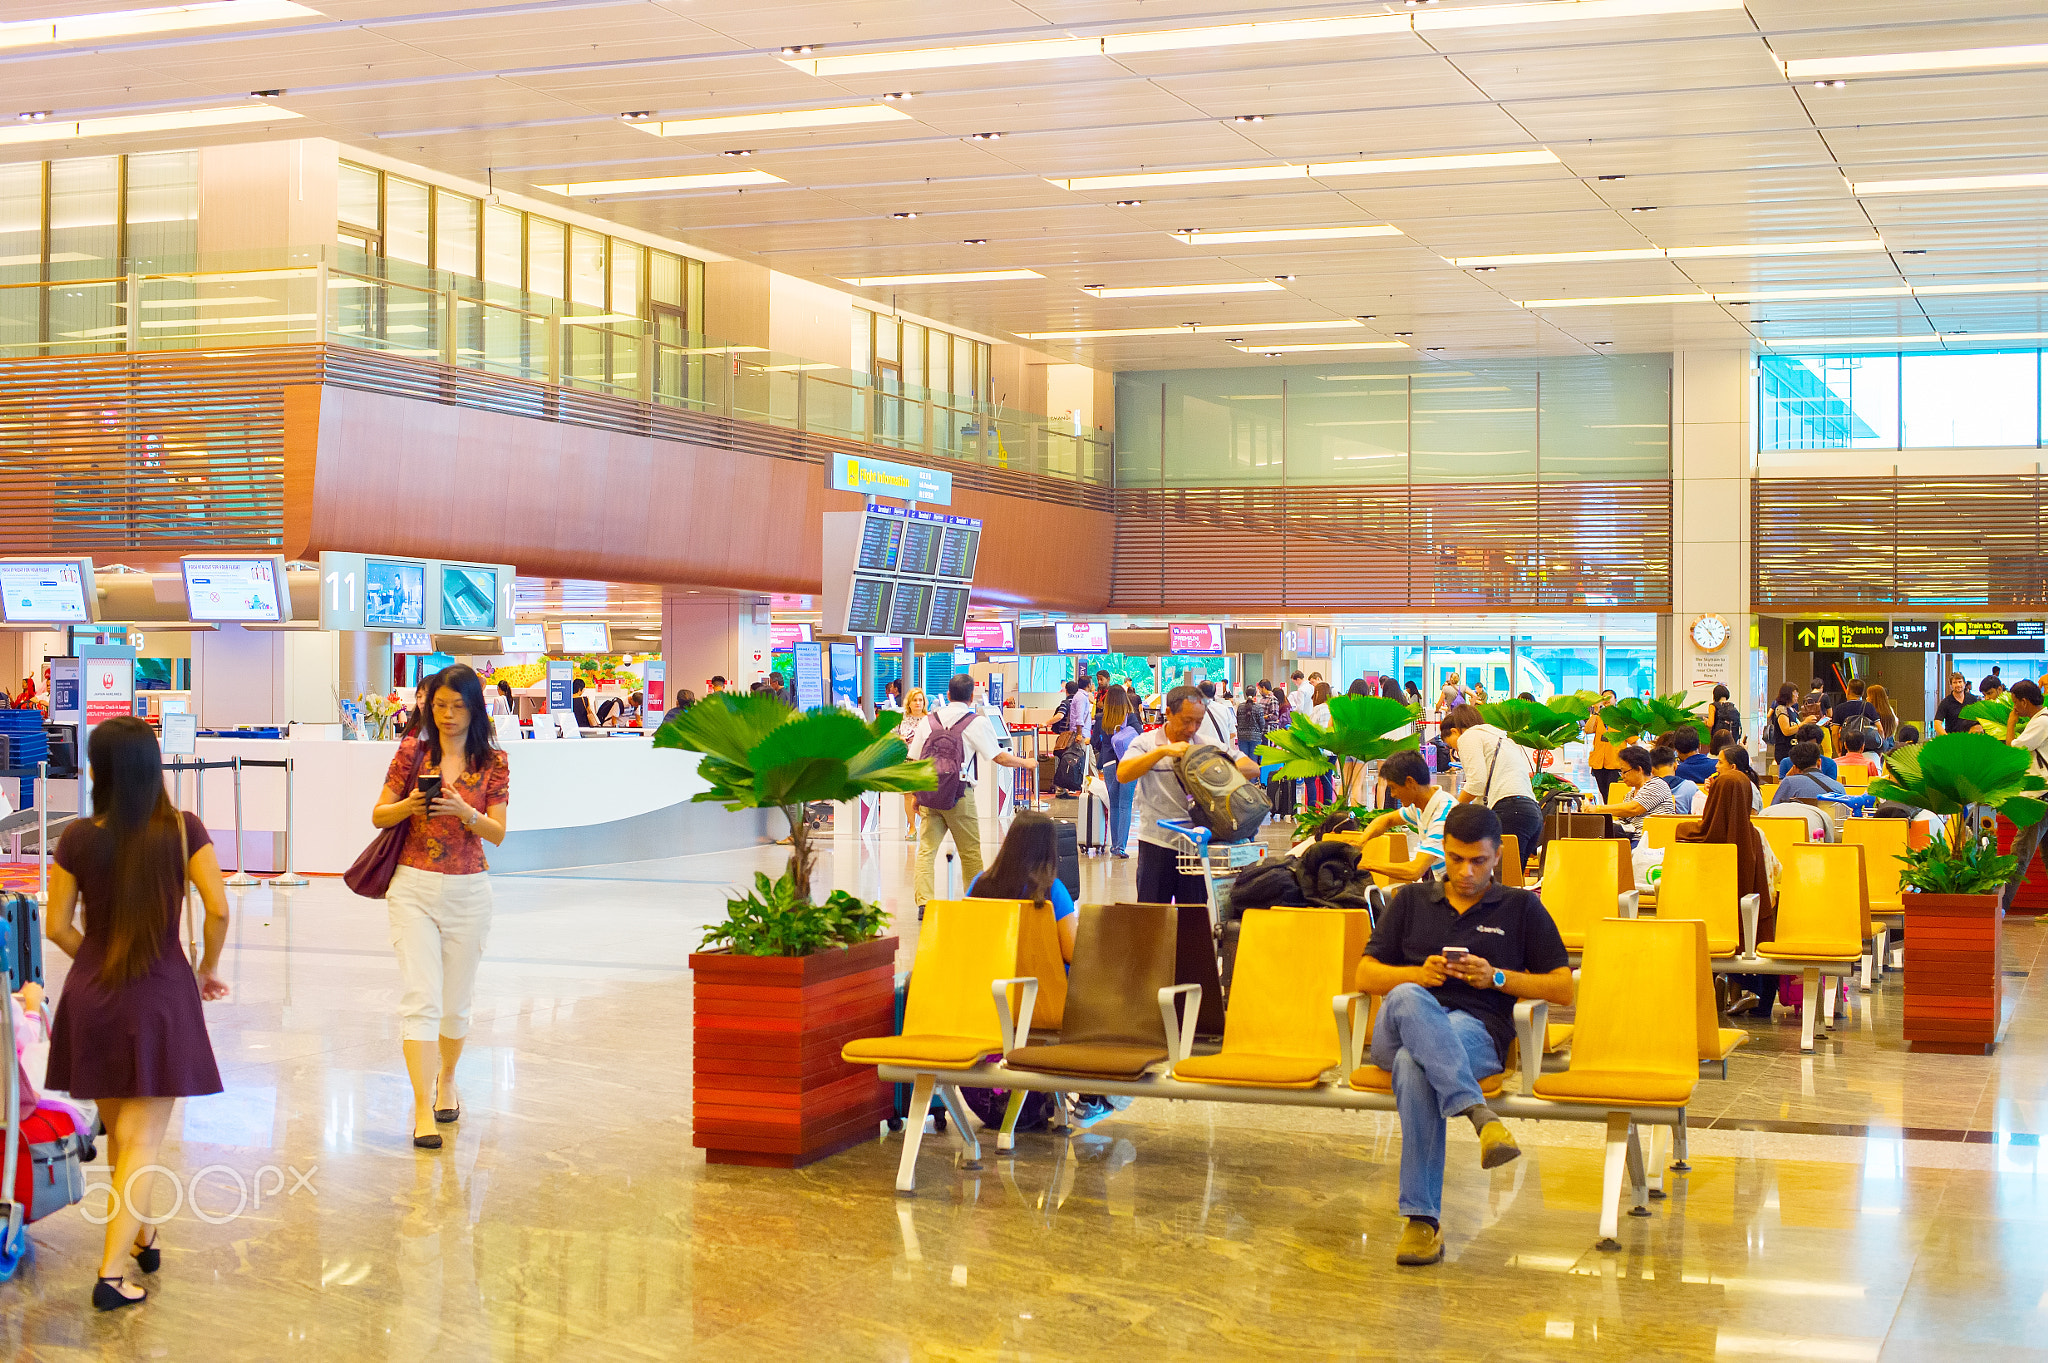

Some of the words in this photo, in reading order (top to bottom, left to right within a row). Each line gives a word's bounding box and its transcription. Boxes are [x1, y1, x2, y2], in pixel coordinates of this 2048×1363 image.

[860, 468, 876, 484] Flight
[877, 471, 910, 488] Information
[326, 571, 355, 612] 11
[1842, 625, 1874, 636] Skytrain
[1874, 626, 1884, 634] to
[1992, 622, 2005, 630] City
[129, 633, 145, 651] 13
[1285, 630, 1297, 651] 13
[1842, 635, 1853, 643] T2
